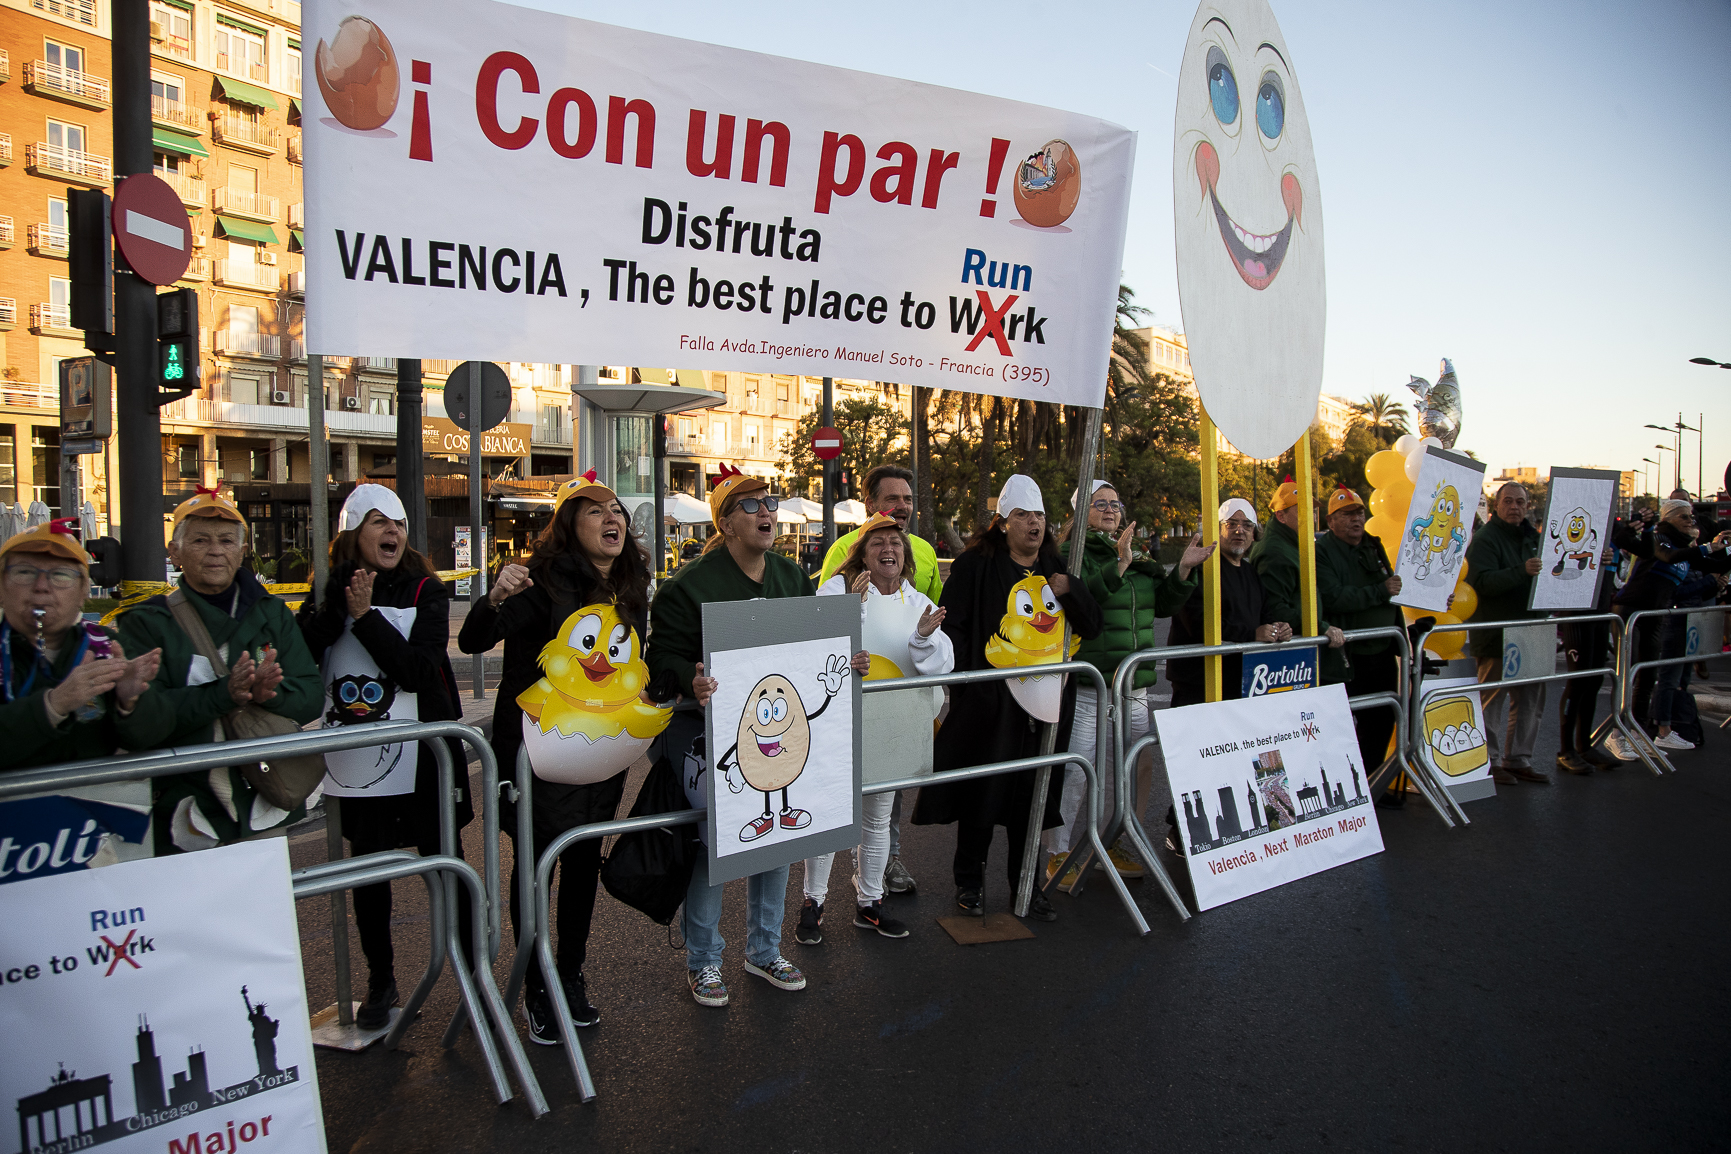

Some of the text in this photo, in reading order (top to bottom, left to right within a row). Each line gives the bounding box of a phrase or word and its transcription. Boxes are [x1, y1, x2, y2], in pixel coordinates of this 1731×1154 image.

[409, 50, 1011, 219] ¡ Con un par !
[641, 197, 822, 263] Disfruta
[335, 229, 568, 297] VALENCIA
[603, 258, 675, 306] The
[688, 267, 774, 313] best
[782, 279, 888, 325] place
[899, 291, 936, 330] to
[961, 247, 1033, 292] Run
[680, 334, 715, 351] Falla
[833, 346, 885, 364] Manuel
[889, 352, 923, 368] Soto
[939, 357, 995, 378] Francia
[1002, 363, 1050, 387] (395)
[444, 433, 485, 452] COS
[484, 435, 527, 454] BLANCA
[1248, 661, 1313, 699] Bertolín
[1300, 711, 1315, 722] Run
[1256, 734, 1273, 747] best
[1273, 732, 1292, 745] place
[1292, 730, 1300, 739] to
[1304, 811, 1321, 820] Berlin
[1194, 826, 1270, 853] Tokio Boston London
[1208, 849, 1258, 876] Valencia
[1264, 838, 1289, 858] Next
[1293, 825, 1335, 848] Maraton
[1337, 816, 1368, 833] Major
[90, 906, 146, 932] Run
[50, 955, 79, 974] to
[126, 1100, 199, 1131] Chicago
[211, 1084, 251, 1105] New
[253, 1069, 294, 1091] York
[168, 1114, 273, 1154] Major
